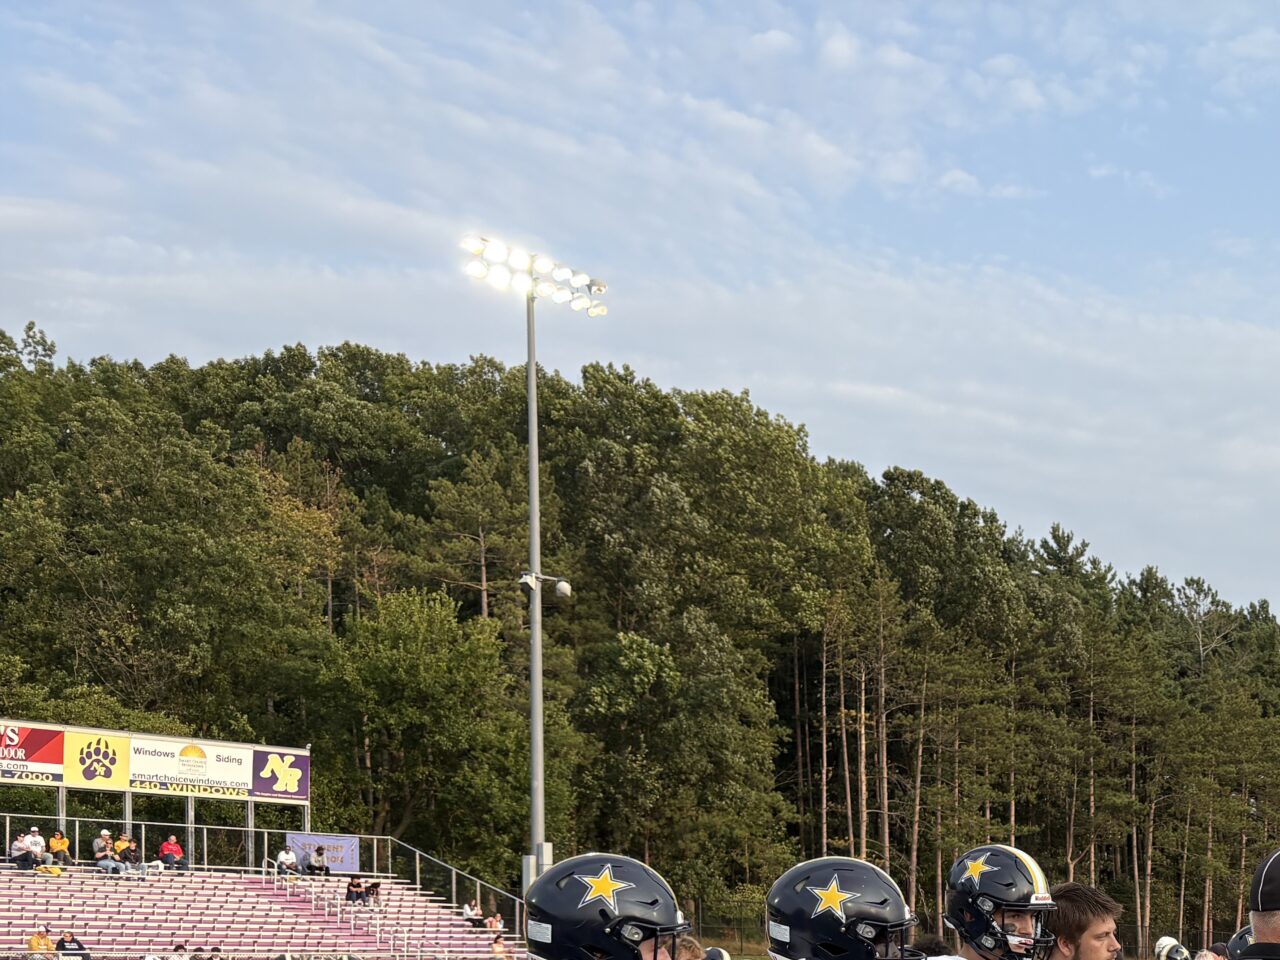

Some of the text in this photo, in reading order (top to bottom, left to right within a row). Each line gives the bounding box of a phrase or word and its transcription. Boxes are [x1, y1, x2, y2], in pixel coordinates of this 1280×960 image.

[133, 746, 176, 759] Windows
[215, 754, 243, 765] Siding
[131, 772, 249, 788] smartchoicewindows.com
[131, 780, 249, 797] 440-WINDOWS
